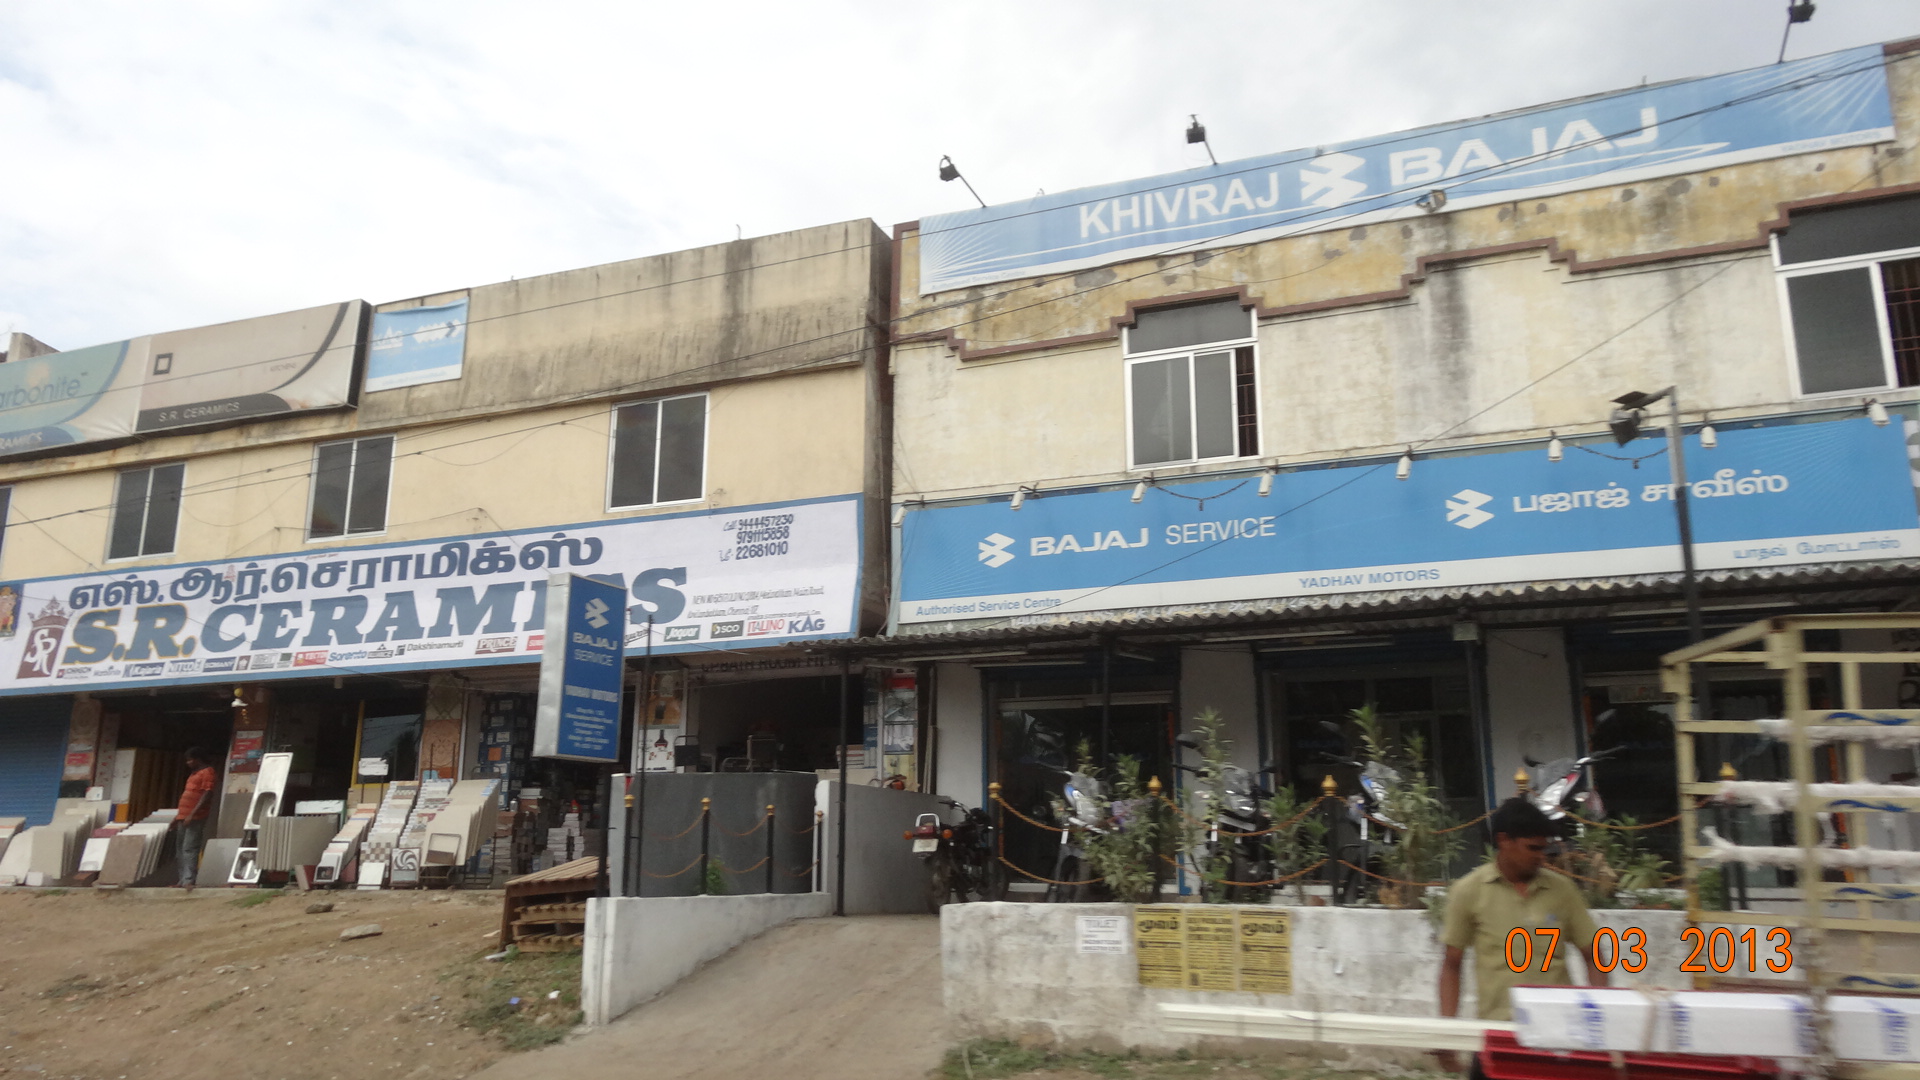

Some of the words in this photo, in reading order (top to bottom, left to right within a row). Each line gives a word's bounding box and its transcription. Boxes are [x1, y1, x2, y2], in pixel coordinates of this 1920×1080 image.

[1079, 172, 1280, 238] KHIVRAJ
[1388, 106, 1659, 186] BAJAJ
[183, 401, 240, 419] CERAMICS
[1030, 528, 1149, 556] BAJAJ
[1165, 516, 1277, 545] SERVICE
[736, 541, 789, 560] 22681010
[1299, 574, 1364, 590] YADHAV
[1368, 569, 1440, 584] MOTORS
[916, 603, 976, 616] Authorised
[979, 599, 1020, 612] Service
[1023, 597, 1061, 609] Centre
[747, 619, 785, 633] ITALINO
[787, 616, 825, 634] KAG
[406, 640, 464, 652] Dakshinamurti
[479, 637, 517, 652] PRINCE
[572, 631, 618, 650] BAJAJ
[574, 648, 613, 667] SERVICE
